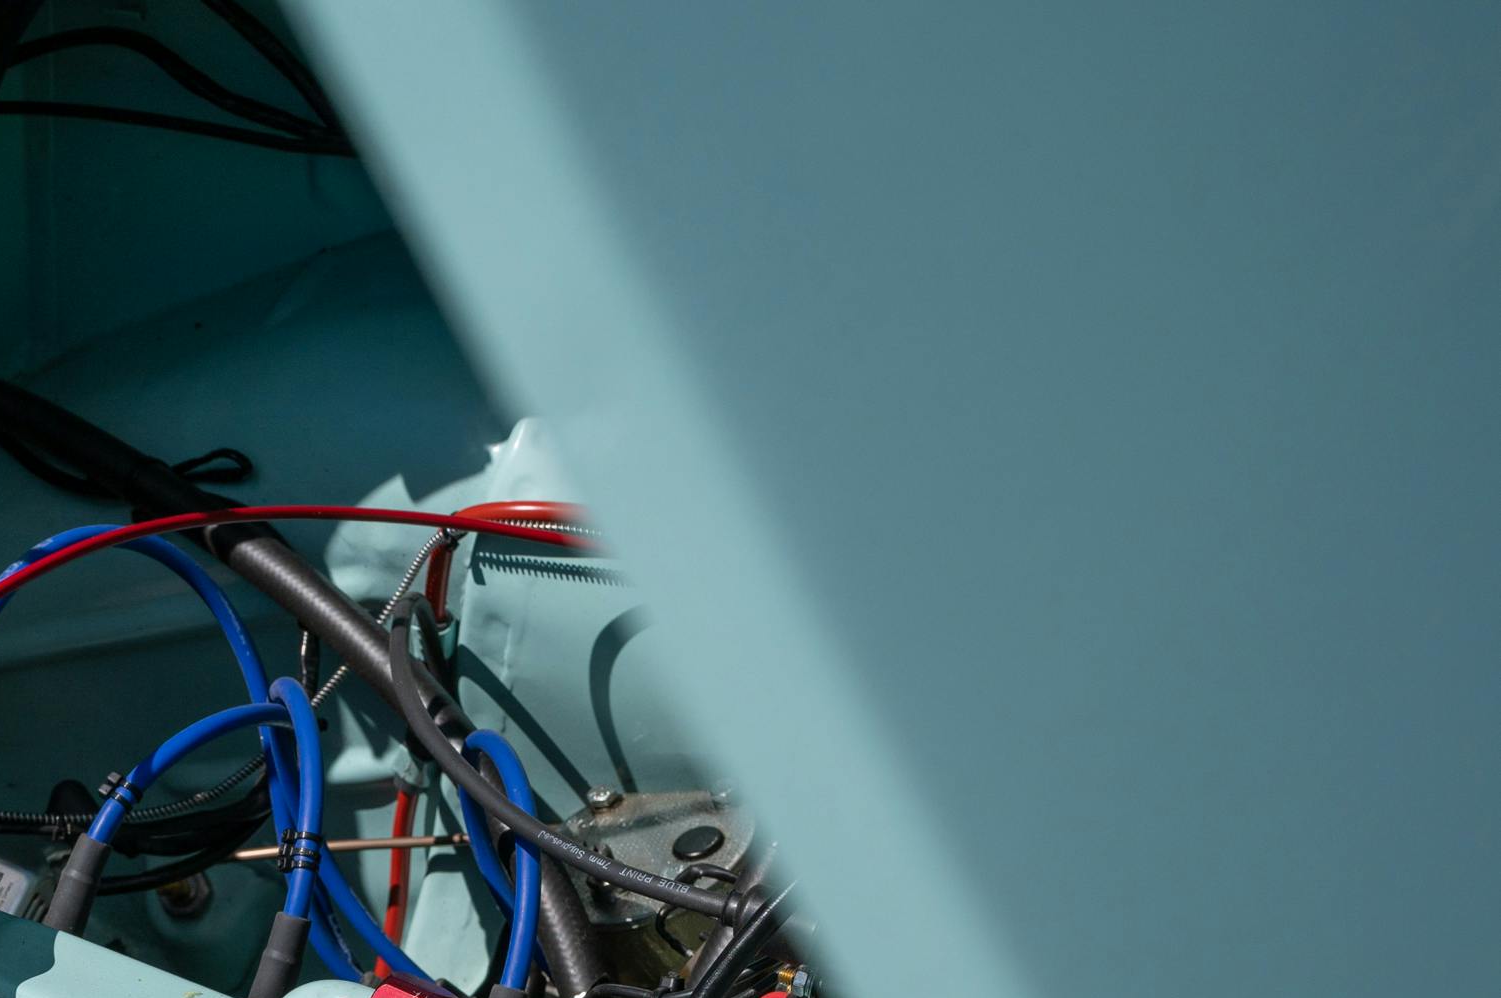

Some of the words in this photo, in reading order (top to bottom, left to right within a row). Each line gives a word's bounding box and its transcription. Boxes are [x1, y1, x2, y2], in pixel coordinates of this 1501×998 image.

[588, 855, 612, 870] 7mm
[618, 867, 654, 884] PRINT
[658, 878, 690, 894] BLUE
